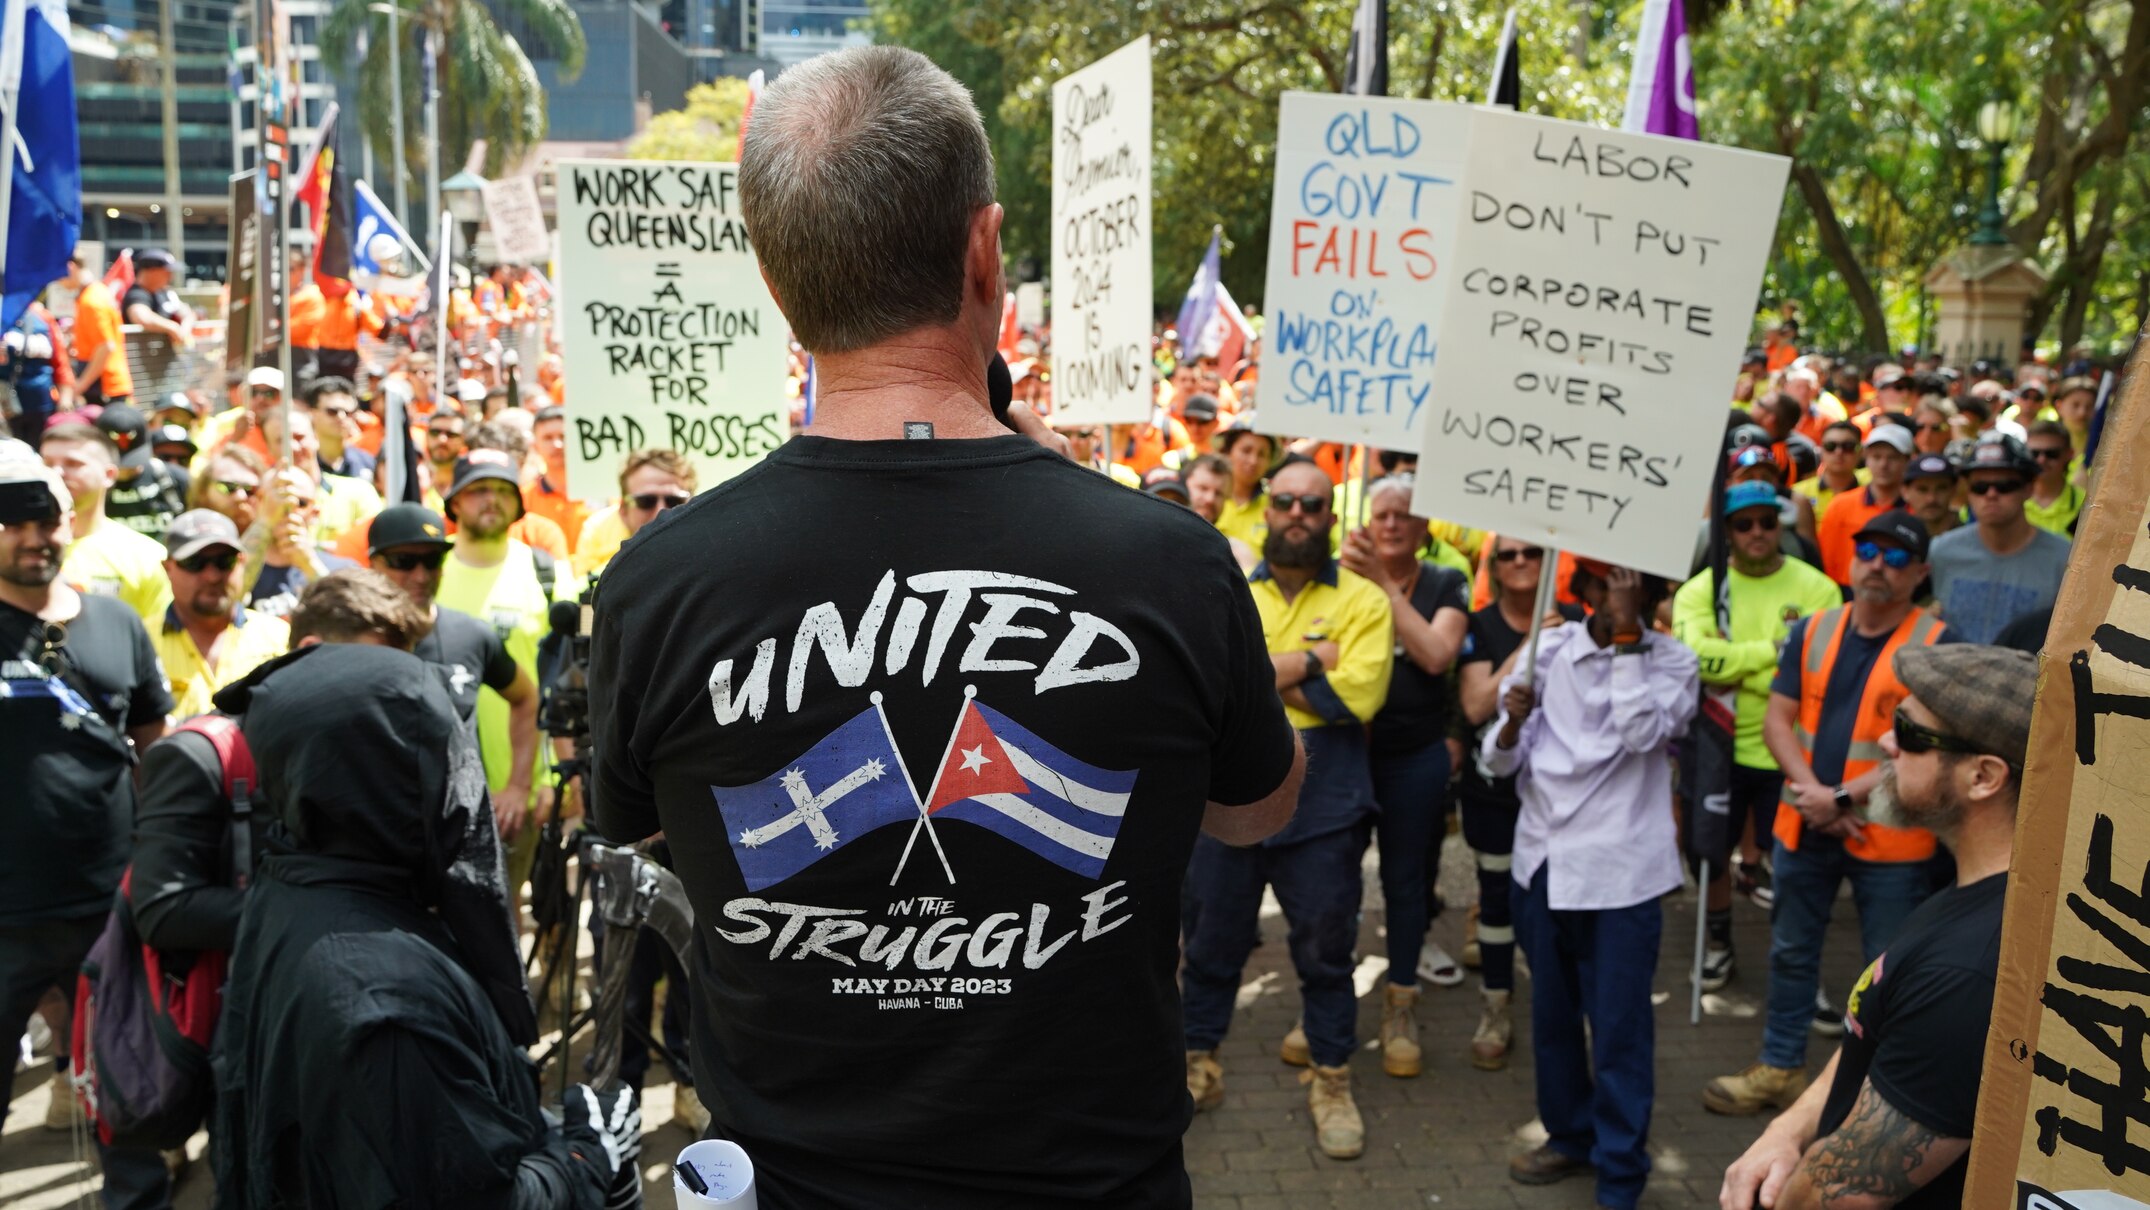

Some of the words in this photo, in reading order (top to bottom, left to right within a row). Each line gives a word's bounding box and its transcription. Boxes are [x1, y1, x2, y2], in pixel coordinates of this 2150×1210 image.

[1325, 109, 1421, 159] QLD
[1533, 131, 1693, 188] LABOR
[676, 166, 735, 215] SAF
[586, 210, 750, 254] QUEENSLAN
[1064, 195, 1140, 259] OCTOBER
[1292, 219, 1437, 281] FAILS
[1471, 189, 1613, 246] DON'T
[1634, 220, 1721, 265] PUT
[653, 280, 684, 304] A
[1071, 259, 1113, 310] 2024
[1330, 288, 1378, 320] ON
[1463, 268, 1713, 337] CORPORATE
[585, 301, 760, 342] PROTECTION
[1084, 310, 1102, 353] IS
[1275, 308, 1438, 370] WORKPLA
[1490, 310, 1674, 376] PROFITS
[604, 341, 735, 376] RACKET
[1056, 343, 1142, 411] LOOMING
[648, 373, 710, 406] FOR
[1284, 358, 1431, 431] SAFETY
[1514, 372, 1627, 416] OVER
[574, 414, 646, 461] BAD
[665, 411, 783, 459] BOSSES
[1442, 408, 1682, 488] WORKERS'
[1463, 467, 1633, 530] SAFETY
[708, 568, 1140, 726] UNITED
[714, 880, 1133, 972] STRUGGLE
[887, 897, 915, 917] IN
[917, 897, 955, 917] THE
[832, 978, 890, 994] MAY
[894, 977, 948, 993] DAY
[950, 978, 1012, 994] 2023
[878, 997, 920, 1010] HAVANA
[934, 996, 964, 1010] CUBA
